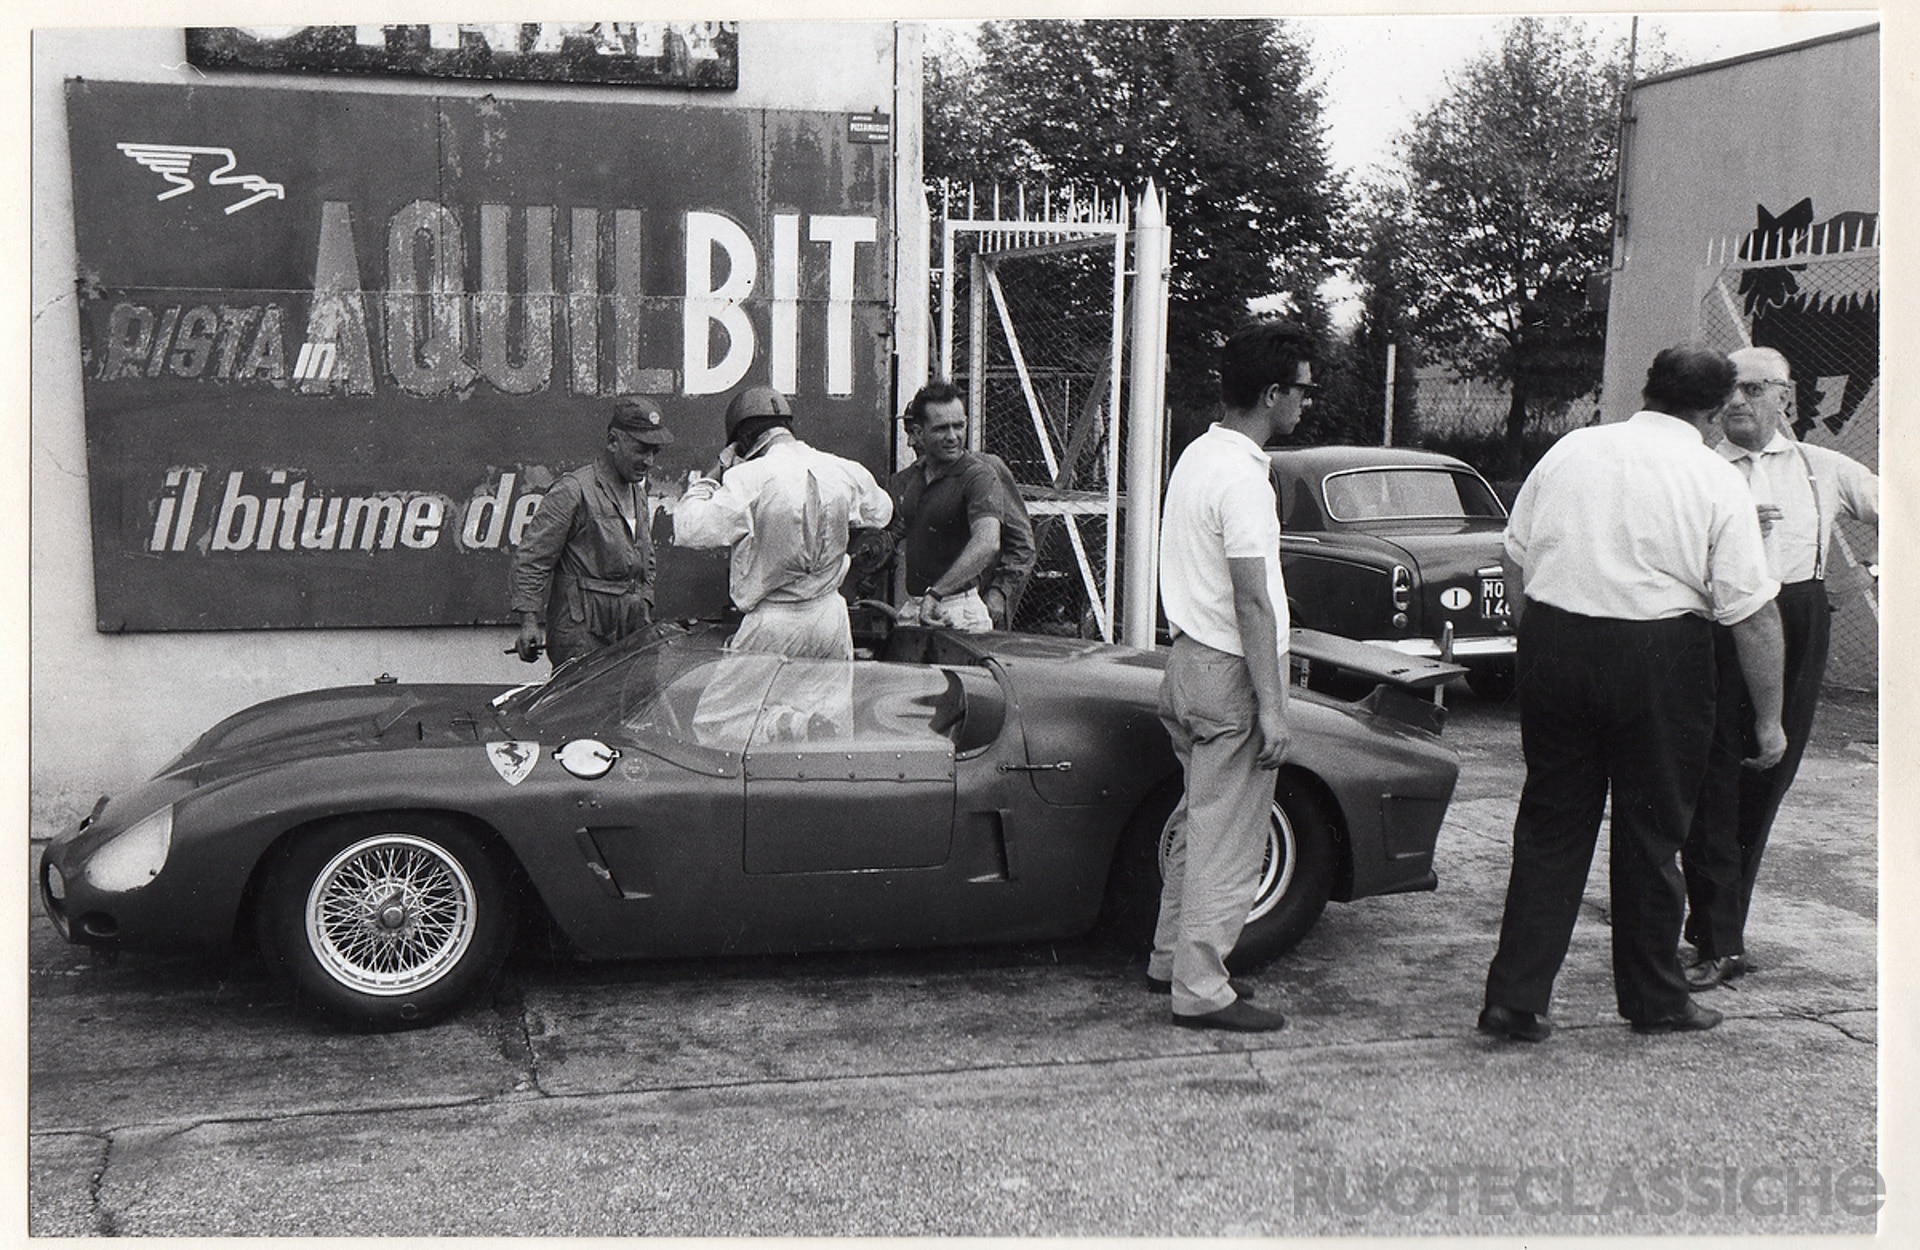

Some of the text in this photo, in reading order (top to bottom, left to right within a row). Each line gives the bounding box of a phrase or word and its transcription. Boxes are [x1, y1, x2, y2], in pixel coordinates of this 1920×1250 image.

[100, 199, 878, 396] PISTA in AQUILBIT
[151, 471, 546, 551] il bitume de
[1483, 581, 1505, 599] MO
